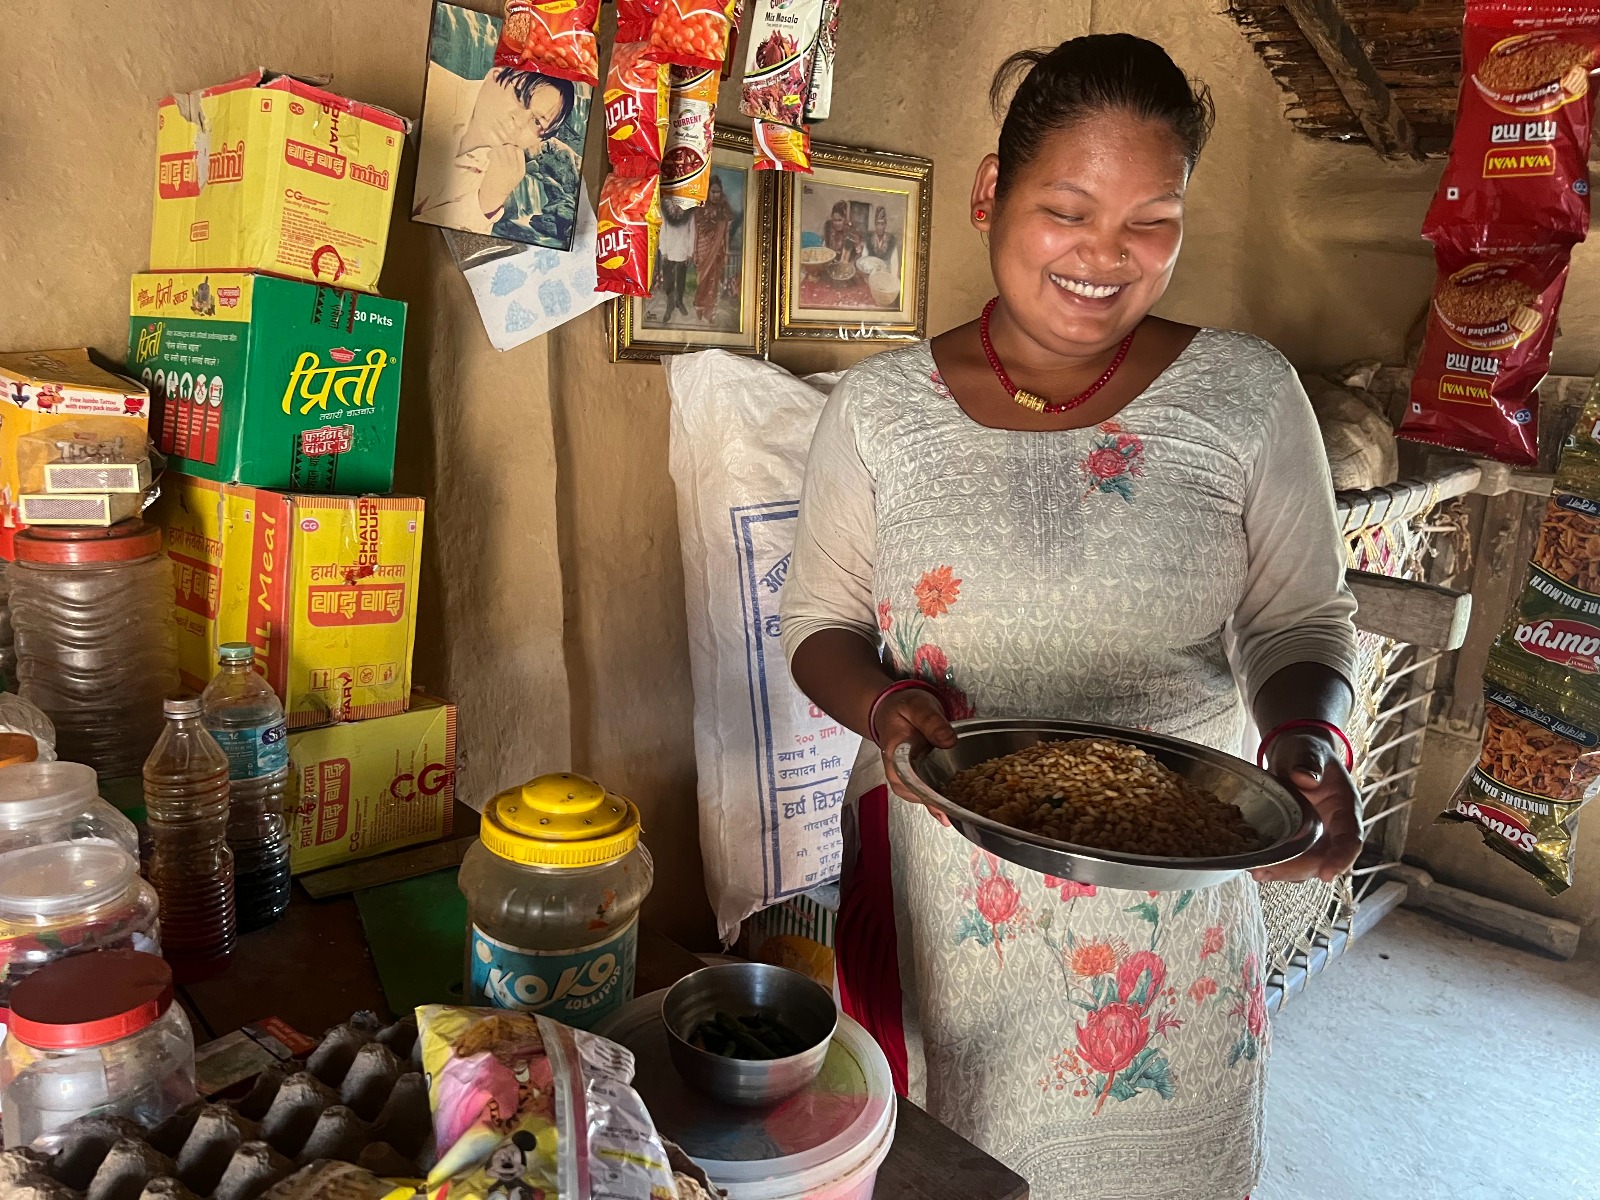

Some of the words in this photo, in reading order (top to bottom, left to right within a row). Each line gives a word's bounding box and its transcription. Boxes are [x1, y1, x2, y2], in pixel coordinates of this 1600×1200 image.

[765, 11, 775, 21] Mix
[776, 12, 798, 23] Masala
[673, 115, 702, 129] CURRENT
[1491, 123, 1521, 143] ma
[1524, 122, 1557, 141] ma
[1488, 156, 1517, 170] WAI
[1520, 155, 1551, 169] WAI
[350, 162, 388, 190] mini
[284, 188, 303, 200] CG
[354, 310, 367, 322] 30
[369, 312, 393, 327] Pkts
[1468, 322, 1509, 337] Crushed
[1446, 353, 1470, 371] ma
[282, 349, 388, 415] प्रिती
[1443, 383, 1464, 395] WAI
[1465, 386, 1489, 399] WAI
[319, 408, 343, 421] तयारी
[302, 522, 318, 530] CG
[257, 511, 276, 612] Meal
[1529, 573, 1584, 616] DALMOTH
[794, 734, 814, 745] २००
[819, 726, 838, 740] ग्राम
[777, 748, 804, 762] ब्याच
[779, 764, 816, 780] उत्पादन
[390, 763, 456, 802] CG
[782, 795, 807, 820] हर्ष
[1499, 790, 1549, 816] MIXTURE
[564, 965, 622, 1011] LOLLIPOP
